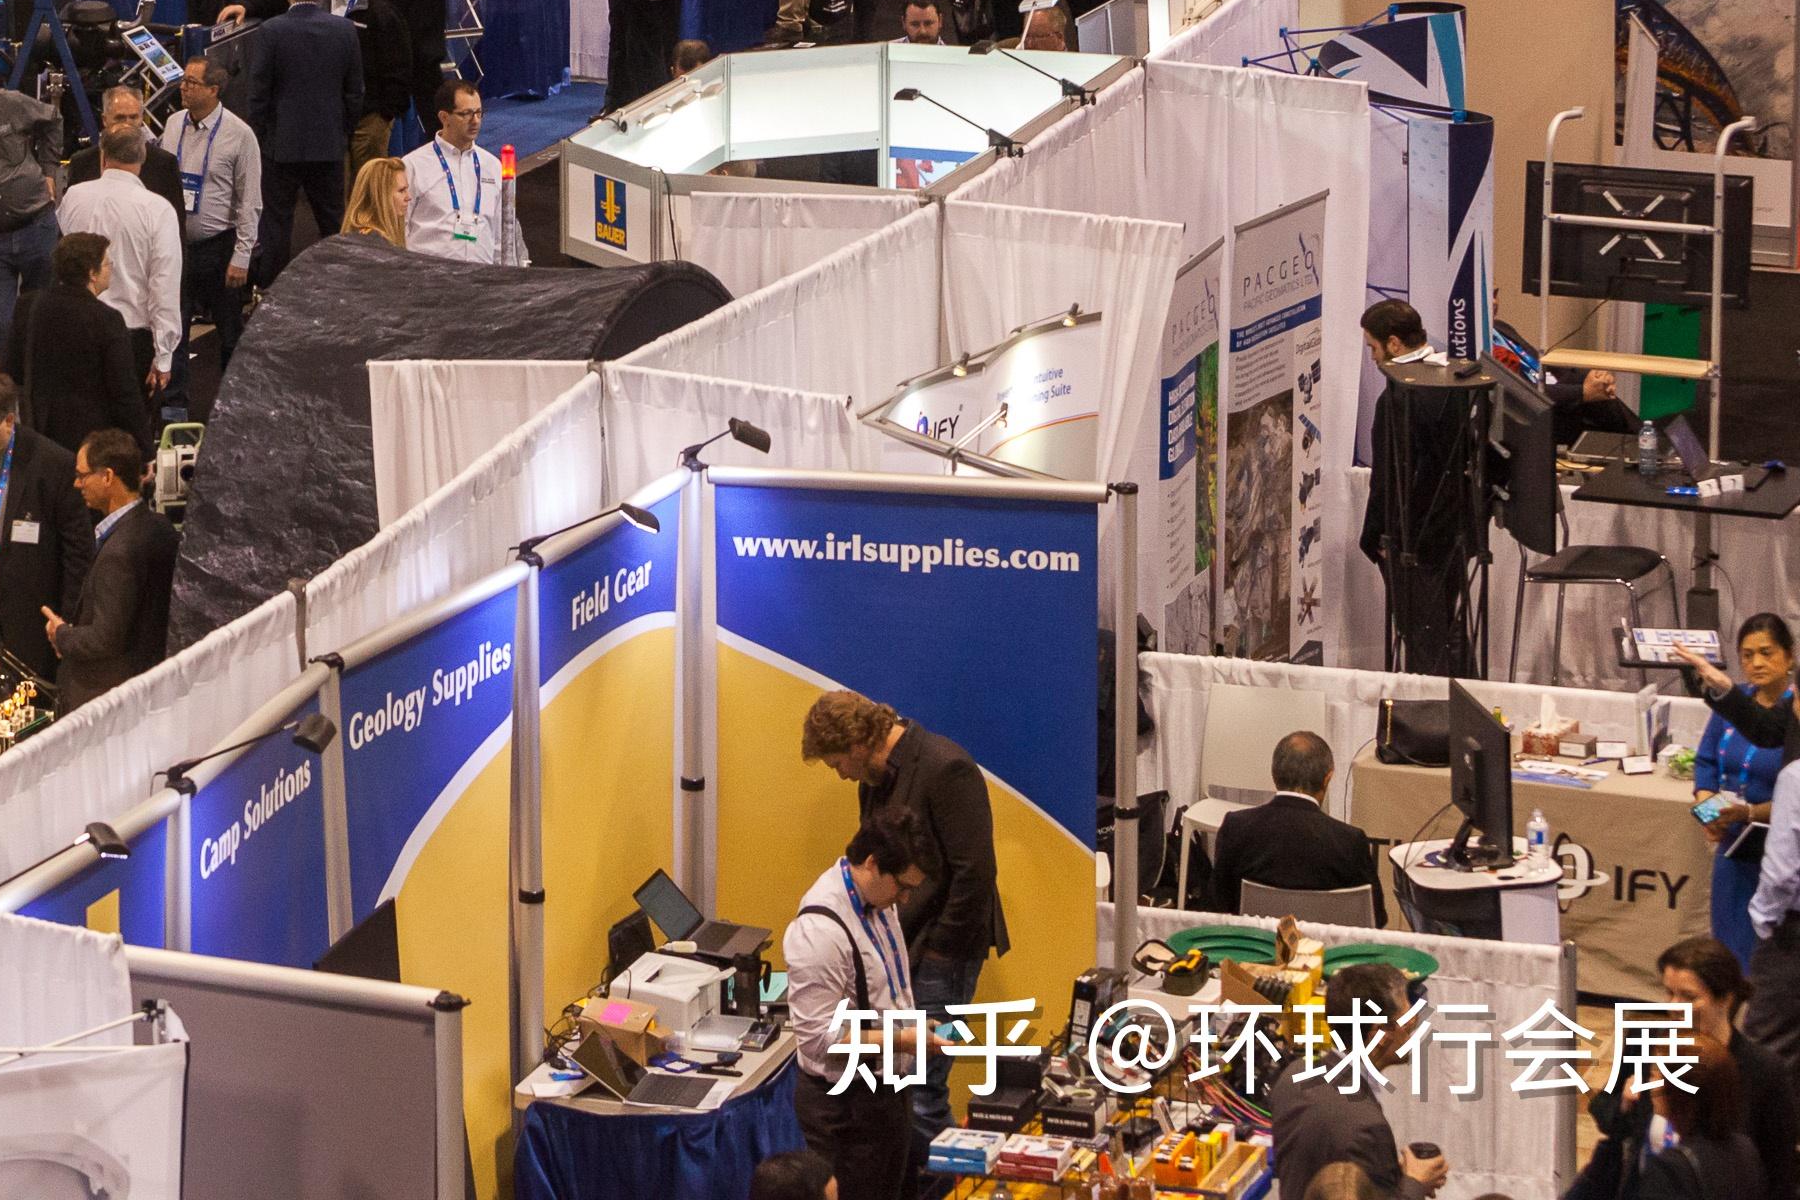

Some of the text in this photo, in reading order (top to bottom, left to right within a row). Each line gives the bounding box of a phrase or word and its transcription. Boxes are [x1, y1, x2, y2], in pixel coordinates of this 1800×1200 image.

[596, 221, 626, 246] BAUER
[1242, 250, 1315, 297] PACGEO
[1049, 383, 1072, 399] Suite
[731, 532, 1081, 575] www.irlsupplies.com
[570, 556, 653, 634] Field Gear
[347, 638, 513, 753] Geology Supplies
[198, 756, 313, 882] Camp Solutions
